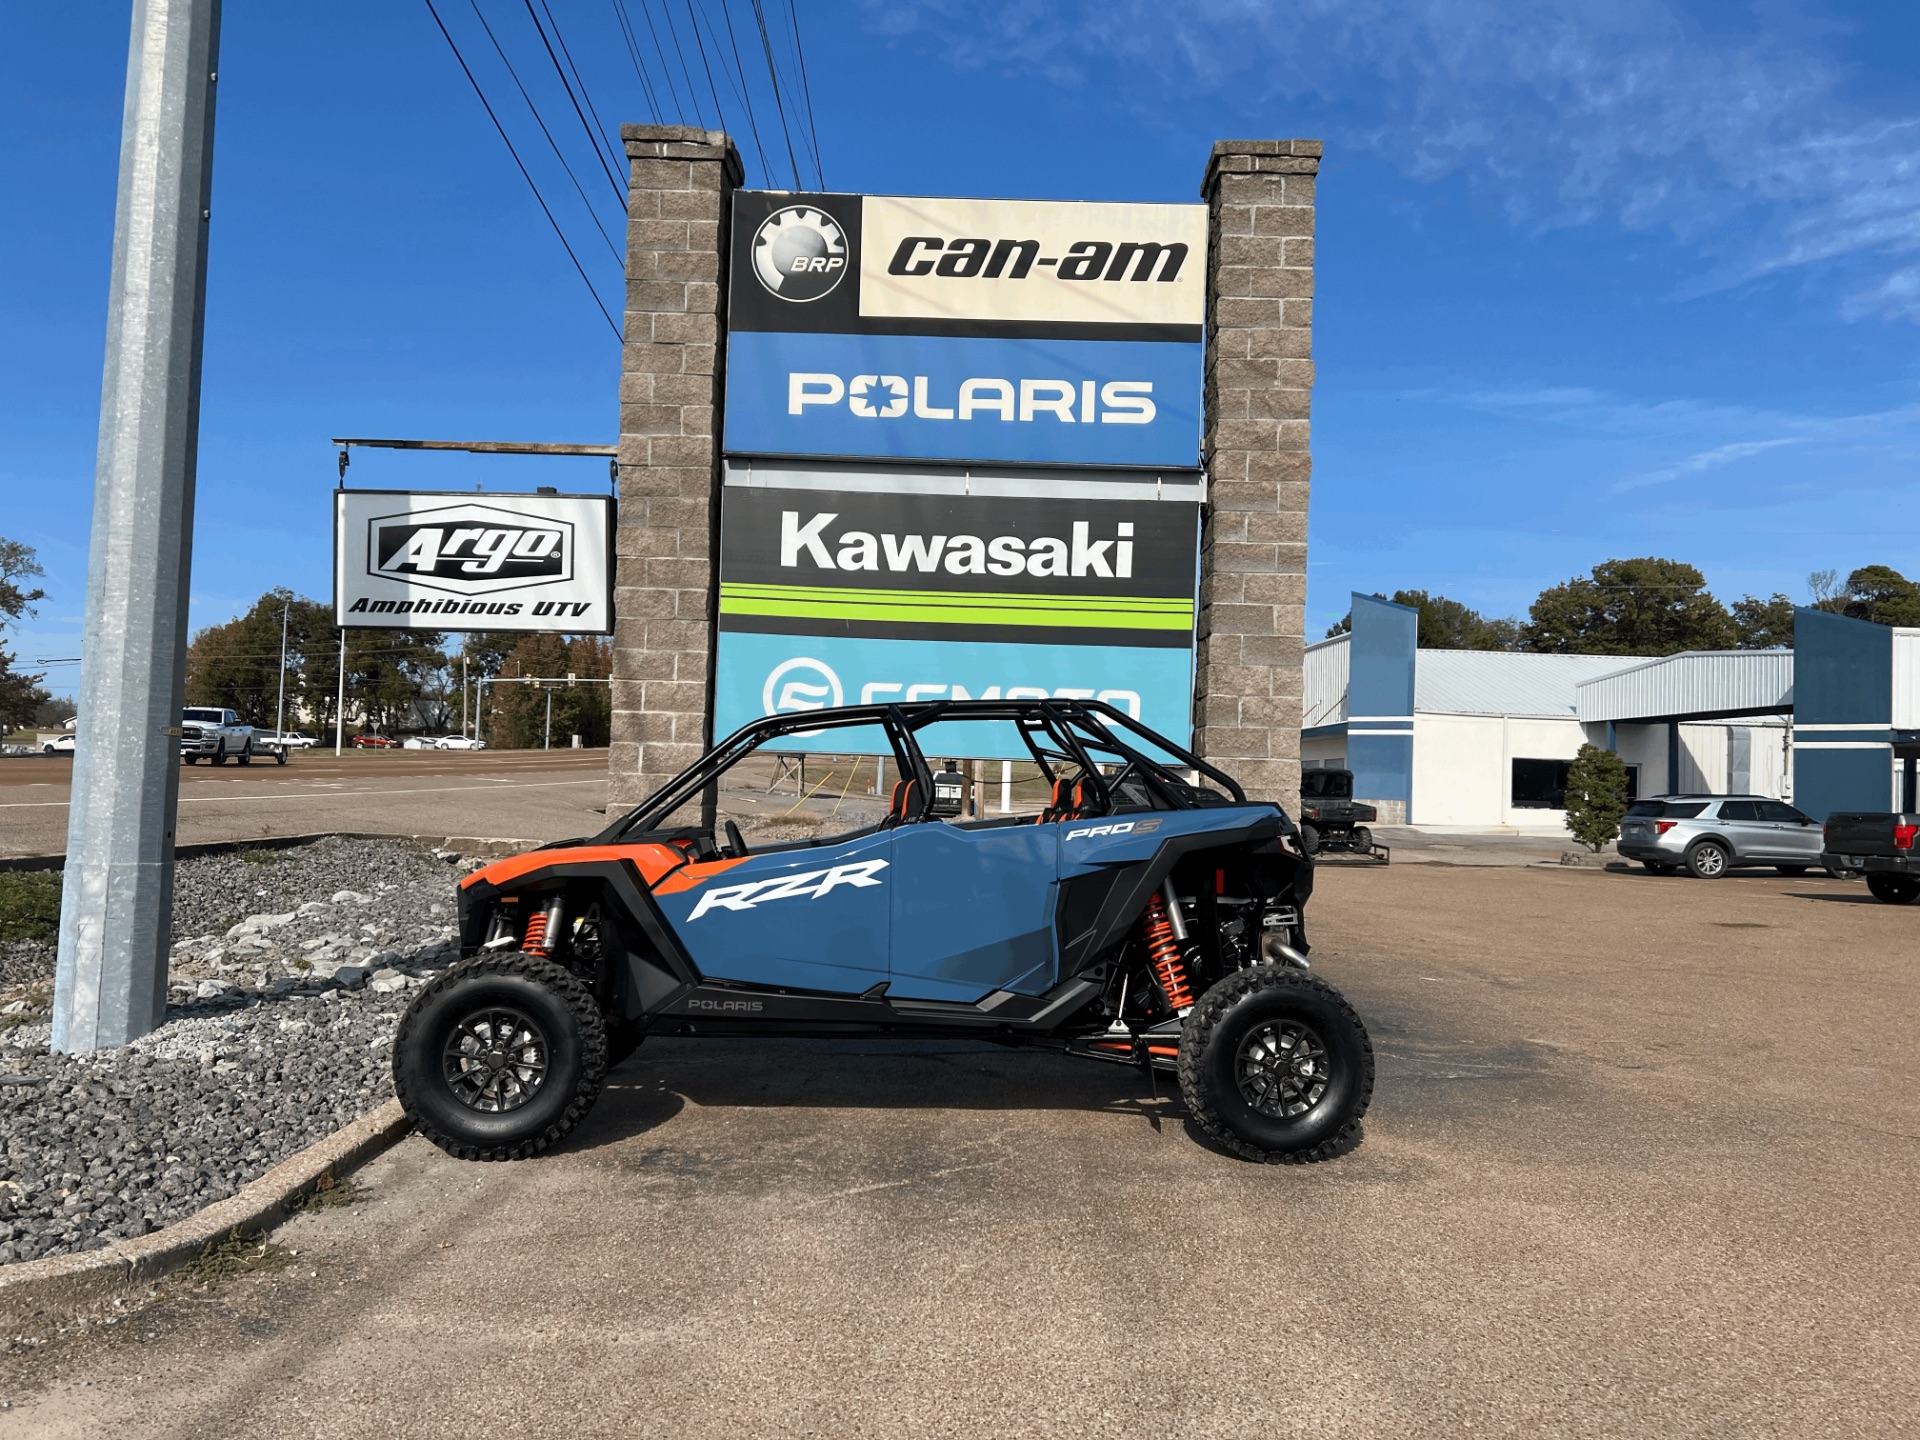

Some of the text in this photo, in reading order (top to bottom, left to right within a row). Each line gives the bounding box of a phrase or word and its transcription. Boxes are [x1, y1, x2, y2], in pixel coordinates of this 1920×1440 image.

[790, 255, 844, 273] BRP
[788, 372, 1157, 425] POLARIS
[780, 510, 1134, 578] Kawasaki
[348, 597, 592, 617] Amphibious UTV
[686, 858, 890, 923] RZR
[688, 1000, 763, 1012] POLARIS
